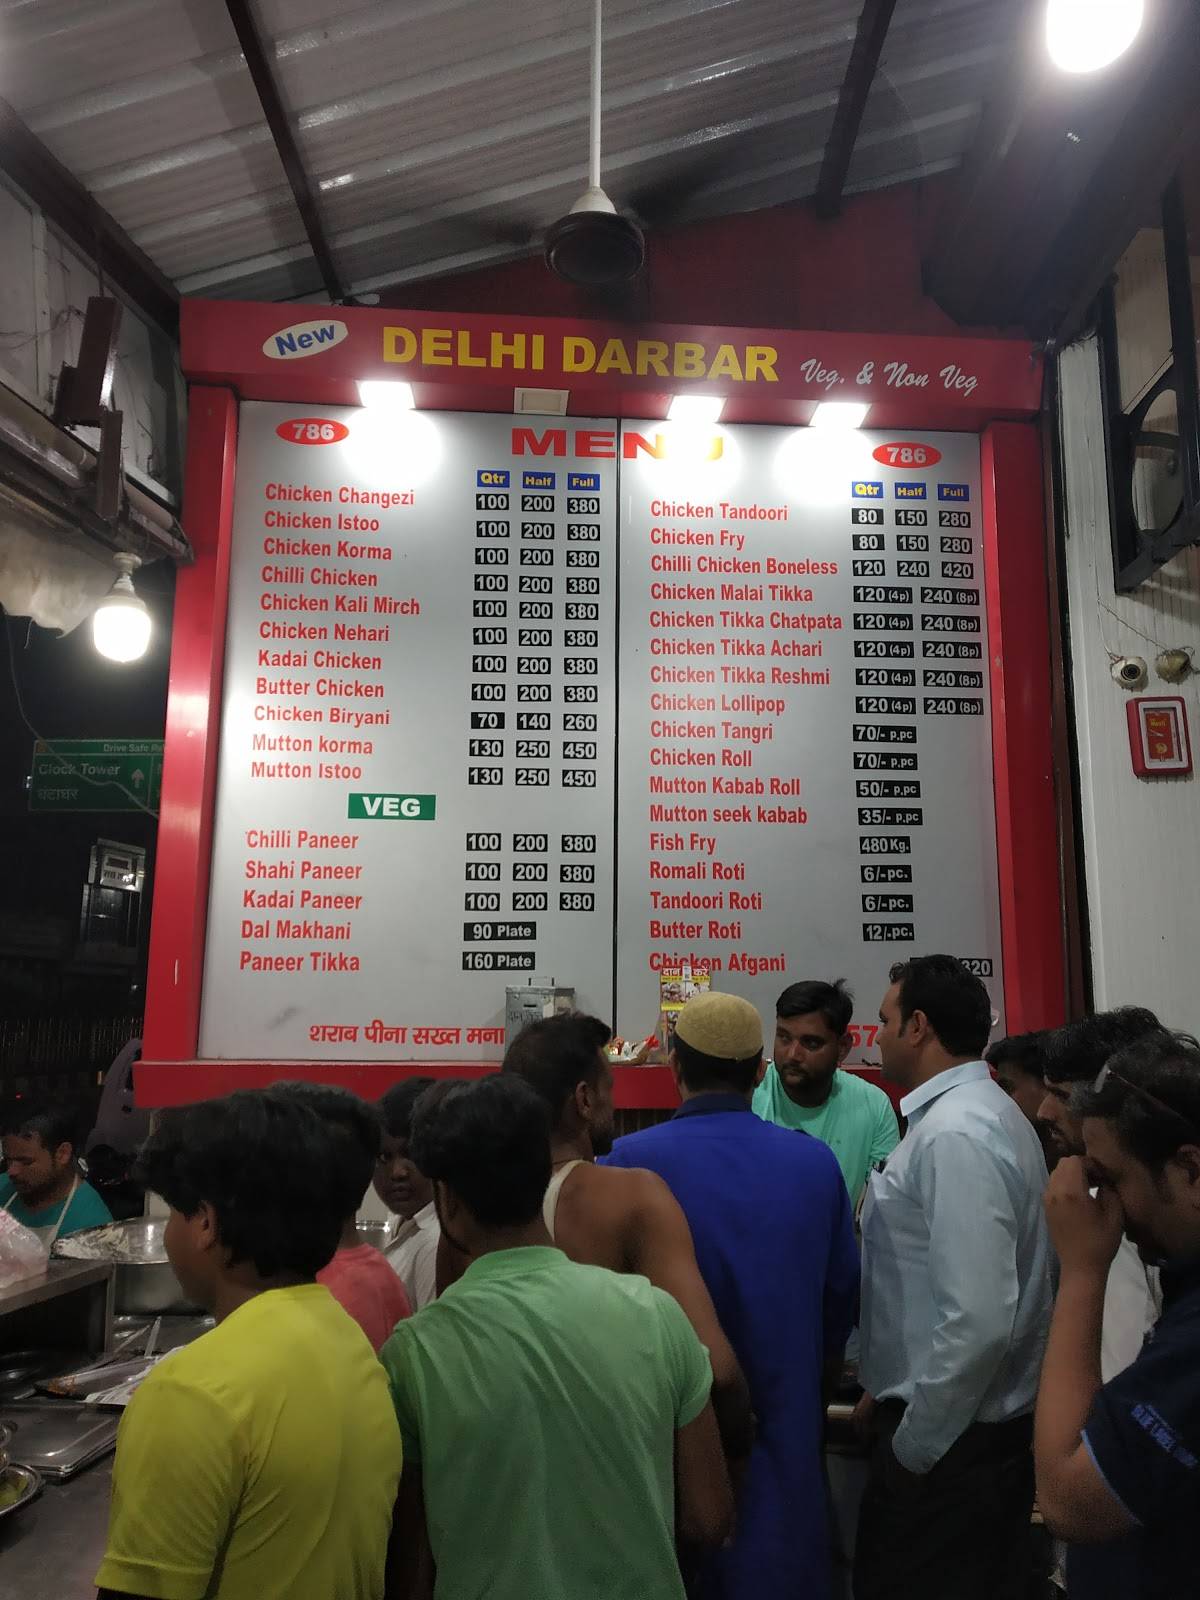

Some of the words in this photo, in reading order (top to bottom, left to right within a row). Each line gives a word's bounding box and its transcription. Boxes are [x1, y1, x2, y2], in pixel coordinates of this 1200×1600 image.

[275, 324, 335, 357] New
[382, 326, 545, 371] DELHI
[562, 336, 779, 382] DARBAR
[800, 358, 845, 391] Veg.
[856, 361, 875, 385] &
[883, 361, 929, 388] Non
[939, 365, 978, 397] Veg
[292, 423, 335, 440] 786
[887, 447, 927, 464] 786
[480, 472, 506, 485] Qtr
[525, 476, 552, 487] Half
[572, 477, 594, 487] Full
[266, 483, 332, 504] Chicken
[338, 486, 415, 509] Changezi
[855, 484, 879, 496] Qtr
[898, 487, 923, 497] Half
[943, 487, 968, 497] Full
[478, 494, 508, 510] 100
[523, 496, 553, 511] 200
[569, 498, 599, 513] 380
[650, 499, 715, 518] Chicken
[720, 502, 789, 521] Tandoori
[262, 509, 333, 529] Chicken
[337, 513, 380, 533] Istoo
[857, 509, 879, 524] 80
[897, 510, 926, 525] 150
[941, 512, 970, 527] 280
[262, 536, 332, 557] Chicken
[336, 541, 393, 560] Korma
[649, 527, 715, 546] Chicken
[720, 528, 745, 552] Fry
[859, 535, 879, 550] 80
[899, 535, 927, 551] 150
[942, 537, 971, 553] 280
[650, 554, 692, 573] Chilli
[696, 555, 762, 574] Chicken
[765, 556, 838, 575] Boneless
[854, 561, 884, 575] 120
[899, 561, 927, 577] 240
[943, 562, 972, 578] 420
[260, 565, 305, 584] Chilli
[308, 566, 378, 587] Chicken
[650, 582, 716, 601] Chicken
[720, 583, 764, 602] Malai
[767, 583, 814, 602] Tikka
[856, 587, 886, 602] 120
[888, 589, 910, 603] (4p)
[923, 588, 953, 604] 240
[955, 591, 977, 605] (8p)
[259, 591, 331, 612] Chicken
[335, 594, 368, 613] Kali
[372, 595, 421, 615] Mirch
[259, 620, 329, 641] Chicken
[334, 623, 389, 641] Nehari
[649, 610, 715, 629] Chicken
[720, 609, 765, 629] Tikka
[769, 610, 844, 633] Chatpata
[475, 628, 505, 644] 100
[520, 630, 550, 645] 200
[567, 631, 597, 646] 380
[649, 638, 716, 656] Chicken
[720, 638, 766, 656] Tikka
[770, 640, 822, 657] Achari
[257, 649, 308, 668] Kadai
[312, 649, 383, 671] Chicken
[650, 665, 715, 683] Chicken
[722, 665, 766, 684] Tikka
[771, 666, 830, 685] Reshmi
[256, 675, 311, 696] Butter
[314, 678, 384, 698] Chicken
[650, 692, 716, 711] Chicken
[721, 695, 785, 714] Lollipop
[858, 697, 888, 713] 120
[891, 700, 913, 714] (4p)
[926, 699, 957, 714] 240
[959, 701, 981, 715] (8p)
[255, 705, 324, 722] Chicken
[328, 706, 391, 728] Biryani
[477, 713, 499, 728] 70
[519, 714, 549, 729] 140
[565, 715, 596, 730] 260
[650, 720, 717, 738] Chicken
[722, 720, 773, 744] Tangri
[855, 726, 886, 742] 70/-
[889, 730, 913, 742] p.pc
[103, 743, 127, 753] Drive
[253, 736, 314, 752] Mutton
[318, 735, 374, 755] korma
[471, 740, 502, 756] 130
[517, 741, 549, 757] 250
[564, 742, 596, 759] 450
[649, 747, 717, 767] Chicken
[721, 748, 752, 767] Roll
[856, 753, 887, 769] 70/-
[890, 757, 914, 769] p.pc
[38, 764, 77, 775] Clock
[80, 763, 121, 775] Tower
[252, 762, 312, 779] Mutton
[318, 762, 362, 780] Istoo
[648, 775, 707, 794] Mutton
[712, 776, 765, 796] Kabab
[769, 776, 800, 796] Roll
[859, 781, 889, 797] 50/-
[893, 785, 917, 797] p.pc
[362, 797, 421, 817] VEG
[649, 804, 708, 822] Mutton
[713, 805, 752, 823] seek
[756, 806, 808, 824] kabab
[861, 808, 892, 825] 35/-
[895, 812, 919, 824] p.pc
[246, 829, 291, 849] Chilli
[297, 828, 359, 849] Paneer
[468, 834, 499, 850] 100
[515, 835, 546, 851] 200
[564, 836, 594, 852] 380
[649, 832, 684, 851] Fish
[689, 832, 716, 855] Fry
[861, 837, 889, 854] 480
[890, 837, 910, 853] Kg.
[244, 858, 296, 880] Shahi
[300, 860, 362, 880] Paneer
[649, 859, 707, 880] Romali
[711, 860, 745, 880] Roti
[863, 866, 909, 882] 6/-pc.
[242, 889, 295, 910] Kadai
[300, 889, 363, 910] Paneer
[650, 890, 724, 911] Tandoori
[728, 890, 762, 911] Roti
[240, 919, 271, 941] Dal
[275, 918, 351, 942] Makhani
[473, 923, 493, 940] 90
[497, 923, 533, 939] Plate
[649, 919, 704, 940] Butter
[707, 920, 742, 940] Roti
[240, 949, 305, 974] Paneer
[310, 951, 361, 973] Tikka
[465, 953, 494, 969] 160
[497, 953, 533, 969] Plate
[649, 952, 722, 972] Chicken
[727, 951, 786, 976] Afgani
[308, 1024, 361, 1044] शराब
[361, 1019, 409, 1045] पीना
[412, 1025, 462, 1047] सख्त
[465, 1025, 505, 1046] मना
